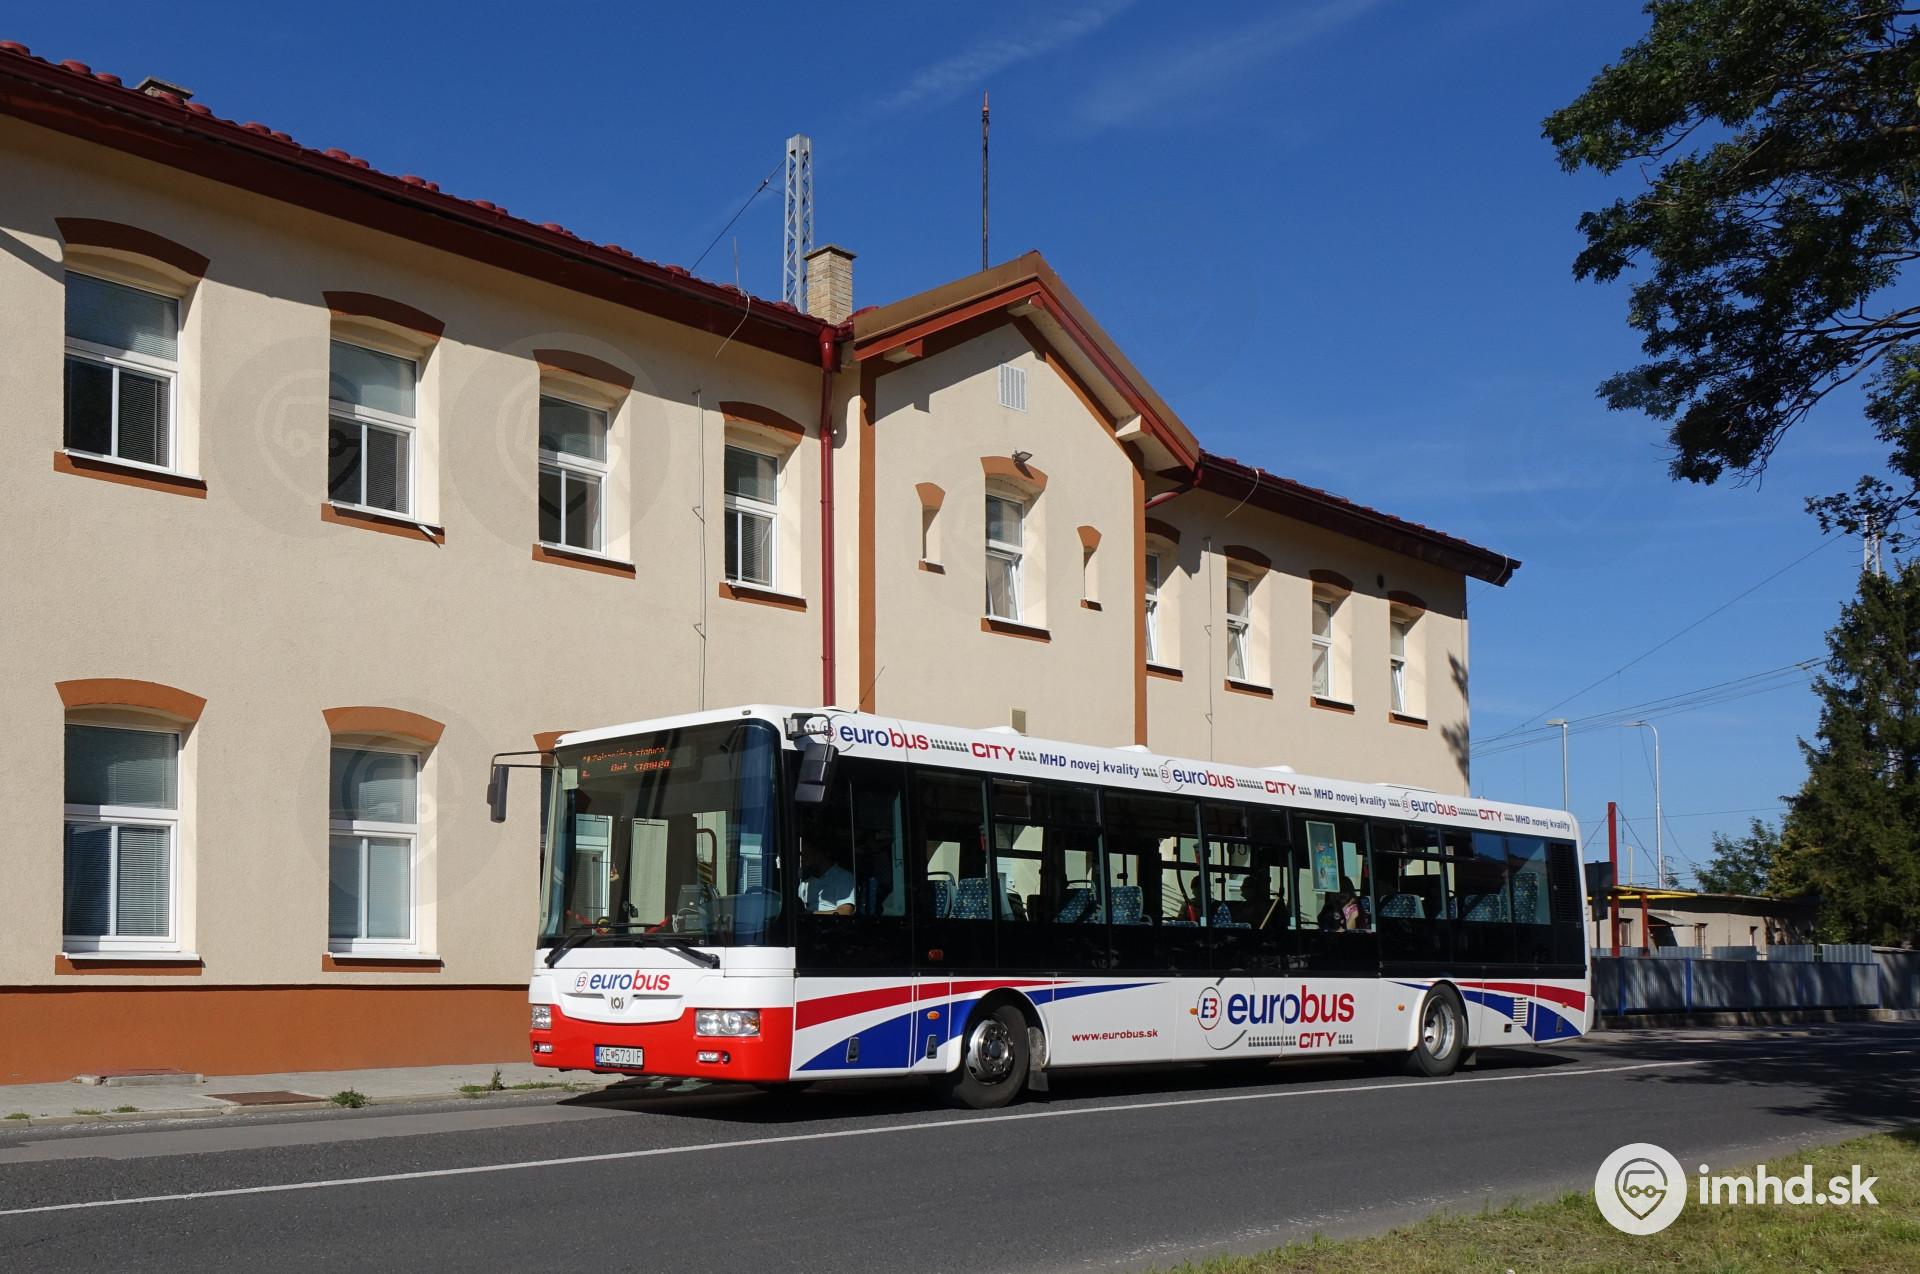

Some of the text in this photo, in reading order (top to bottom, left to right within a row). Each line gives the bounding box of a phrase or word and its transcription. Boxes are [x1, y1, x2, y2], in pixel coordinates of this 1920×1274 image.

[840, 725, 929, 750] eurobus
[971, 742, 1016, 761] CITY
[1039, 752, 1067, 767] MHD
[1070, 758, 1100, 775] novej
[1103, 760, 1140, 779] kvality
[1173, 769, 1236, 789] eurobus
[1264, 780, 1297, 796] CITY
[1313, 788, 1334, 800] MHD
[1335, 793, 1358, 806] novej
[1359, 795, 1387, 809] kvality
[1411, 798, 1458, 817] eurobus
[1478, 808, 1502, 822] CITY
[1515, 814, 1531, 825] MHD
[1531, 818, 1549, 830] novej
[1549, 819, 1571, 832] kvality
[589, 970, 671, 991] eurobus
[1227, 985, 1355, 1025] eurobus
[1072, 1028, 1158, 1042] www.eurobus.sk
[1298, 1032, 1337, 1049] CITY
